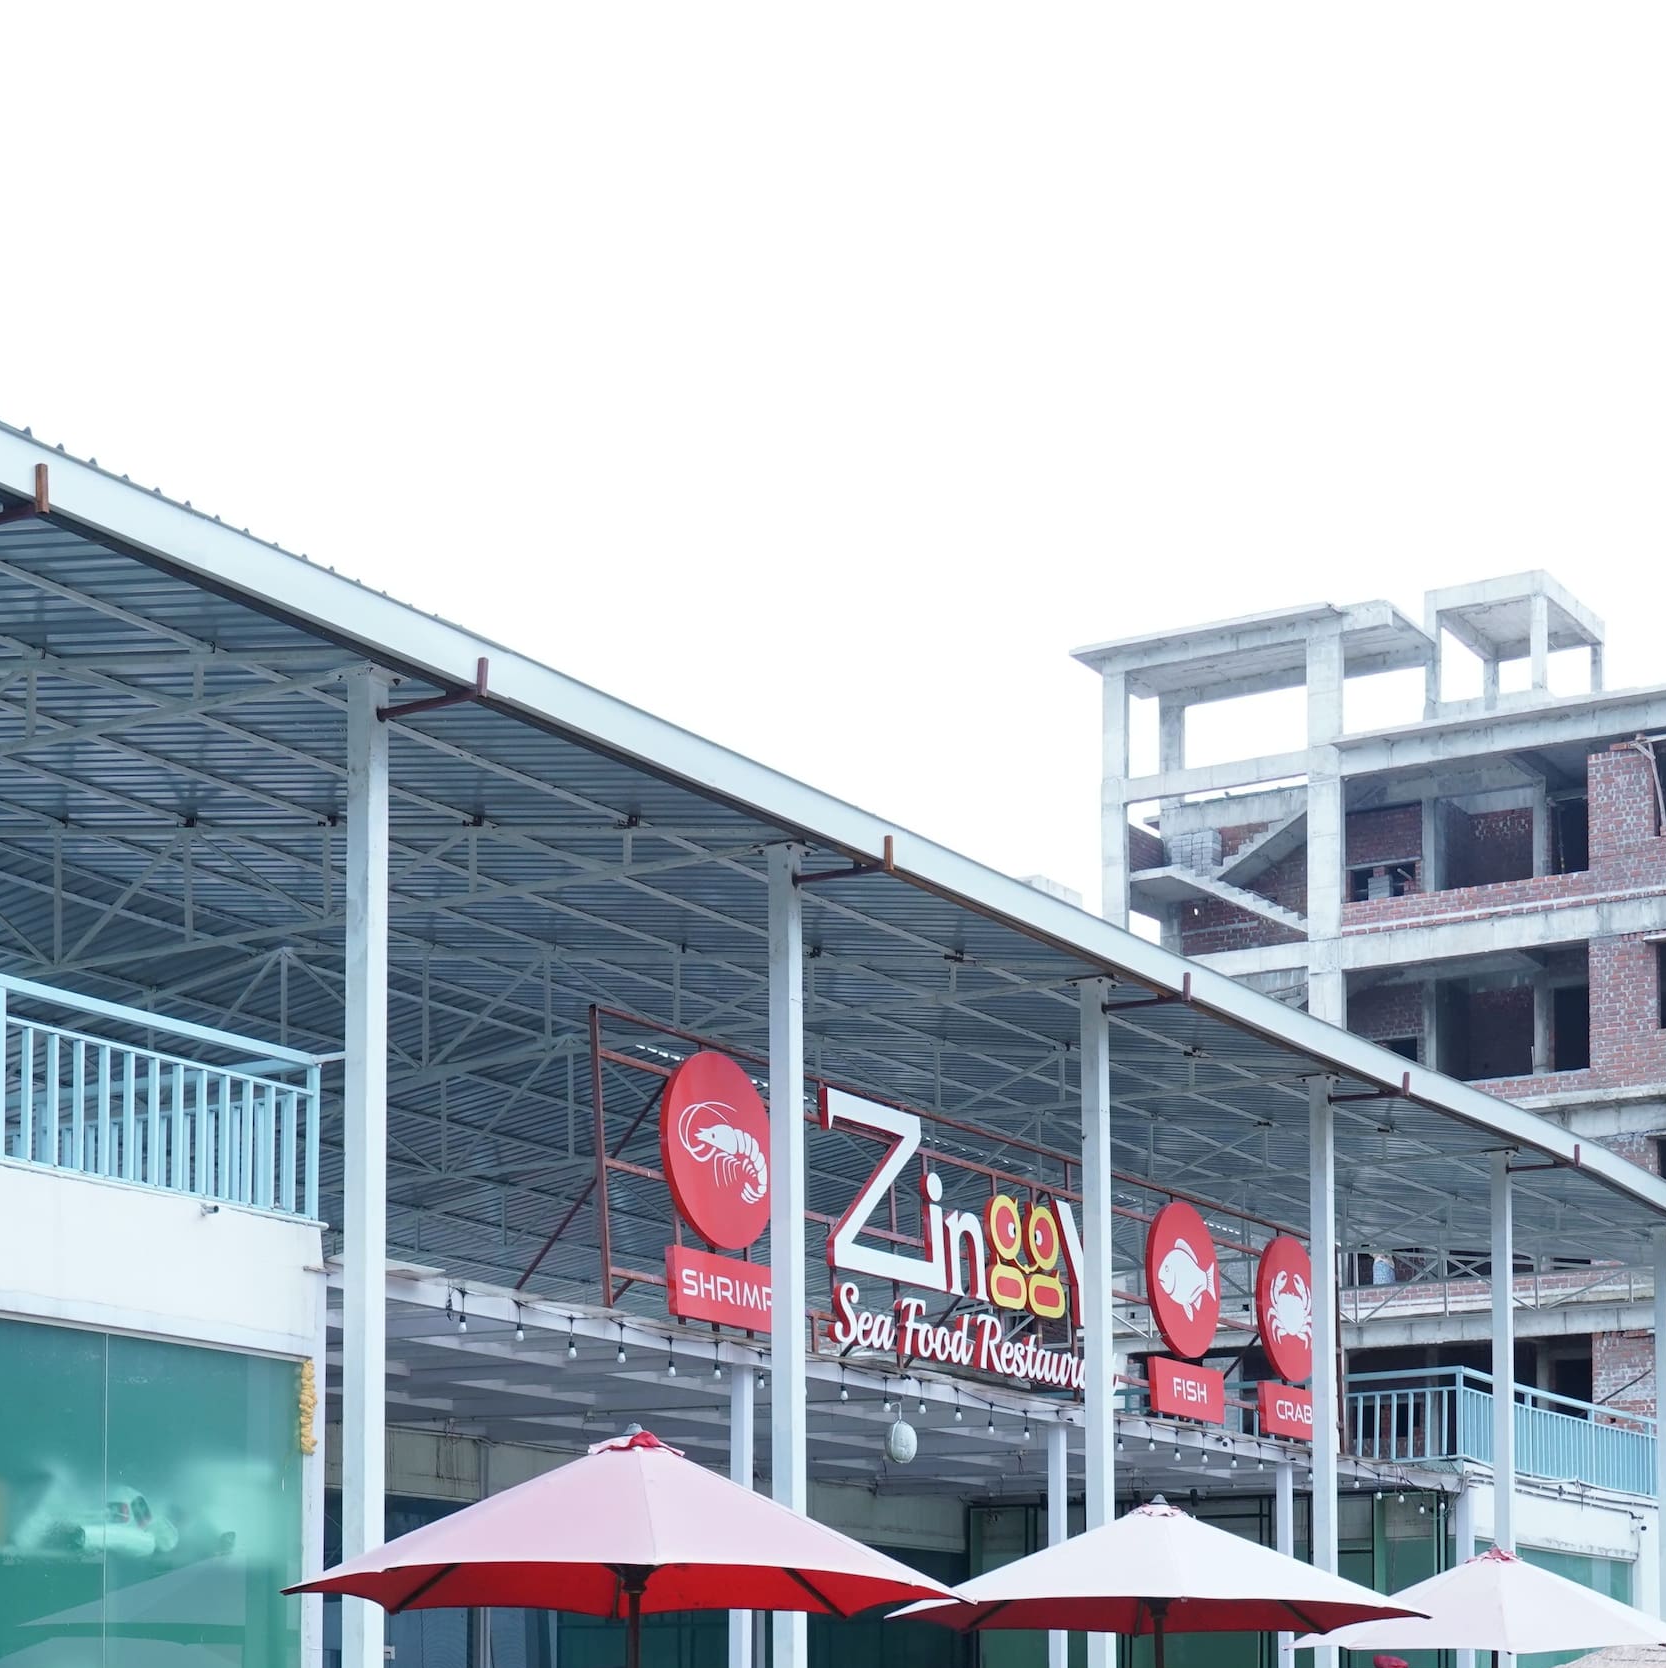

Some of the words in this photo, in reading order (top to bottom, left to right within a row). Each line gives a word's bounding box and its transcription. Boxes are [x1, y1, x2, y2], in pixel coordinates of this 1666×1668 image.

[832, 1282, 895, 1350] Sea
[898, 1297, 975, 1366] Food
[976, 1314, 1119, 1395] Restaura
[1173, 1376, 1207, 1404] FISH
[1276, 1400, 1313, 1424] CRAB
